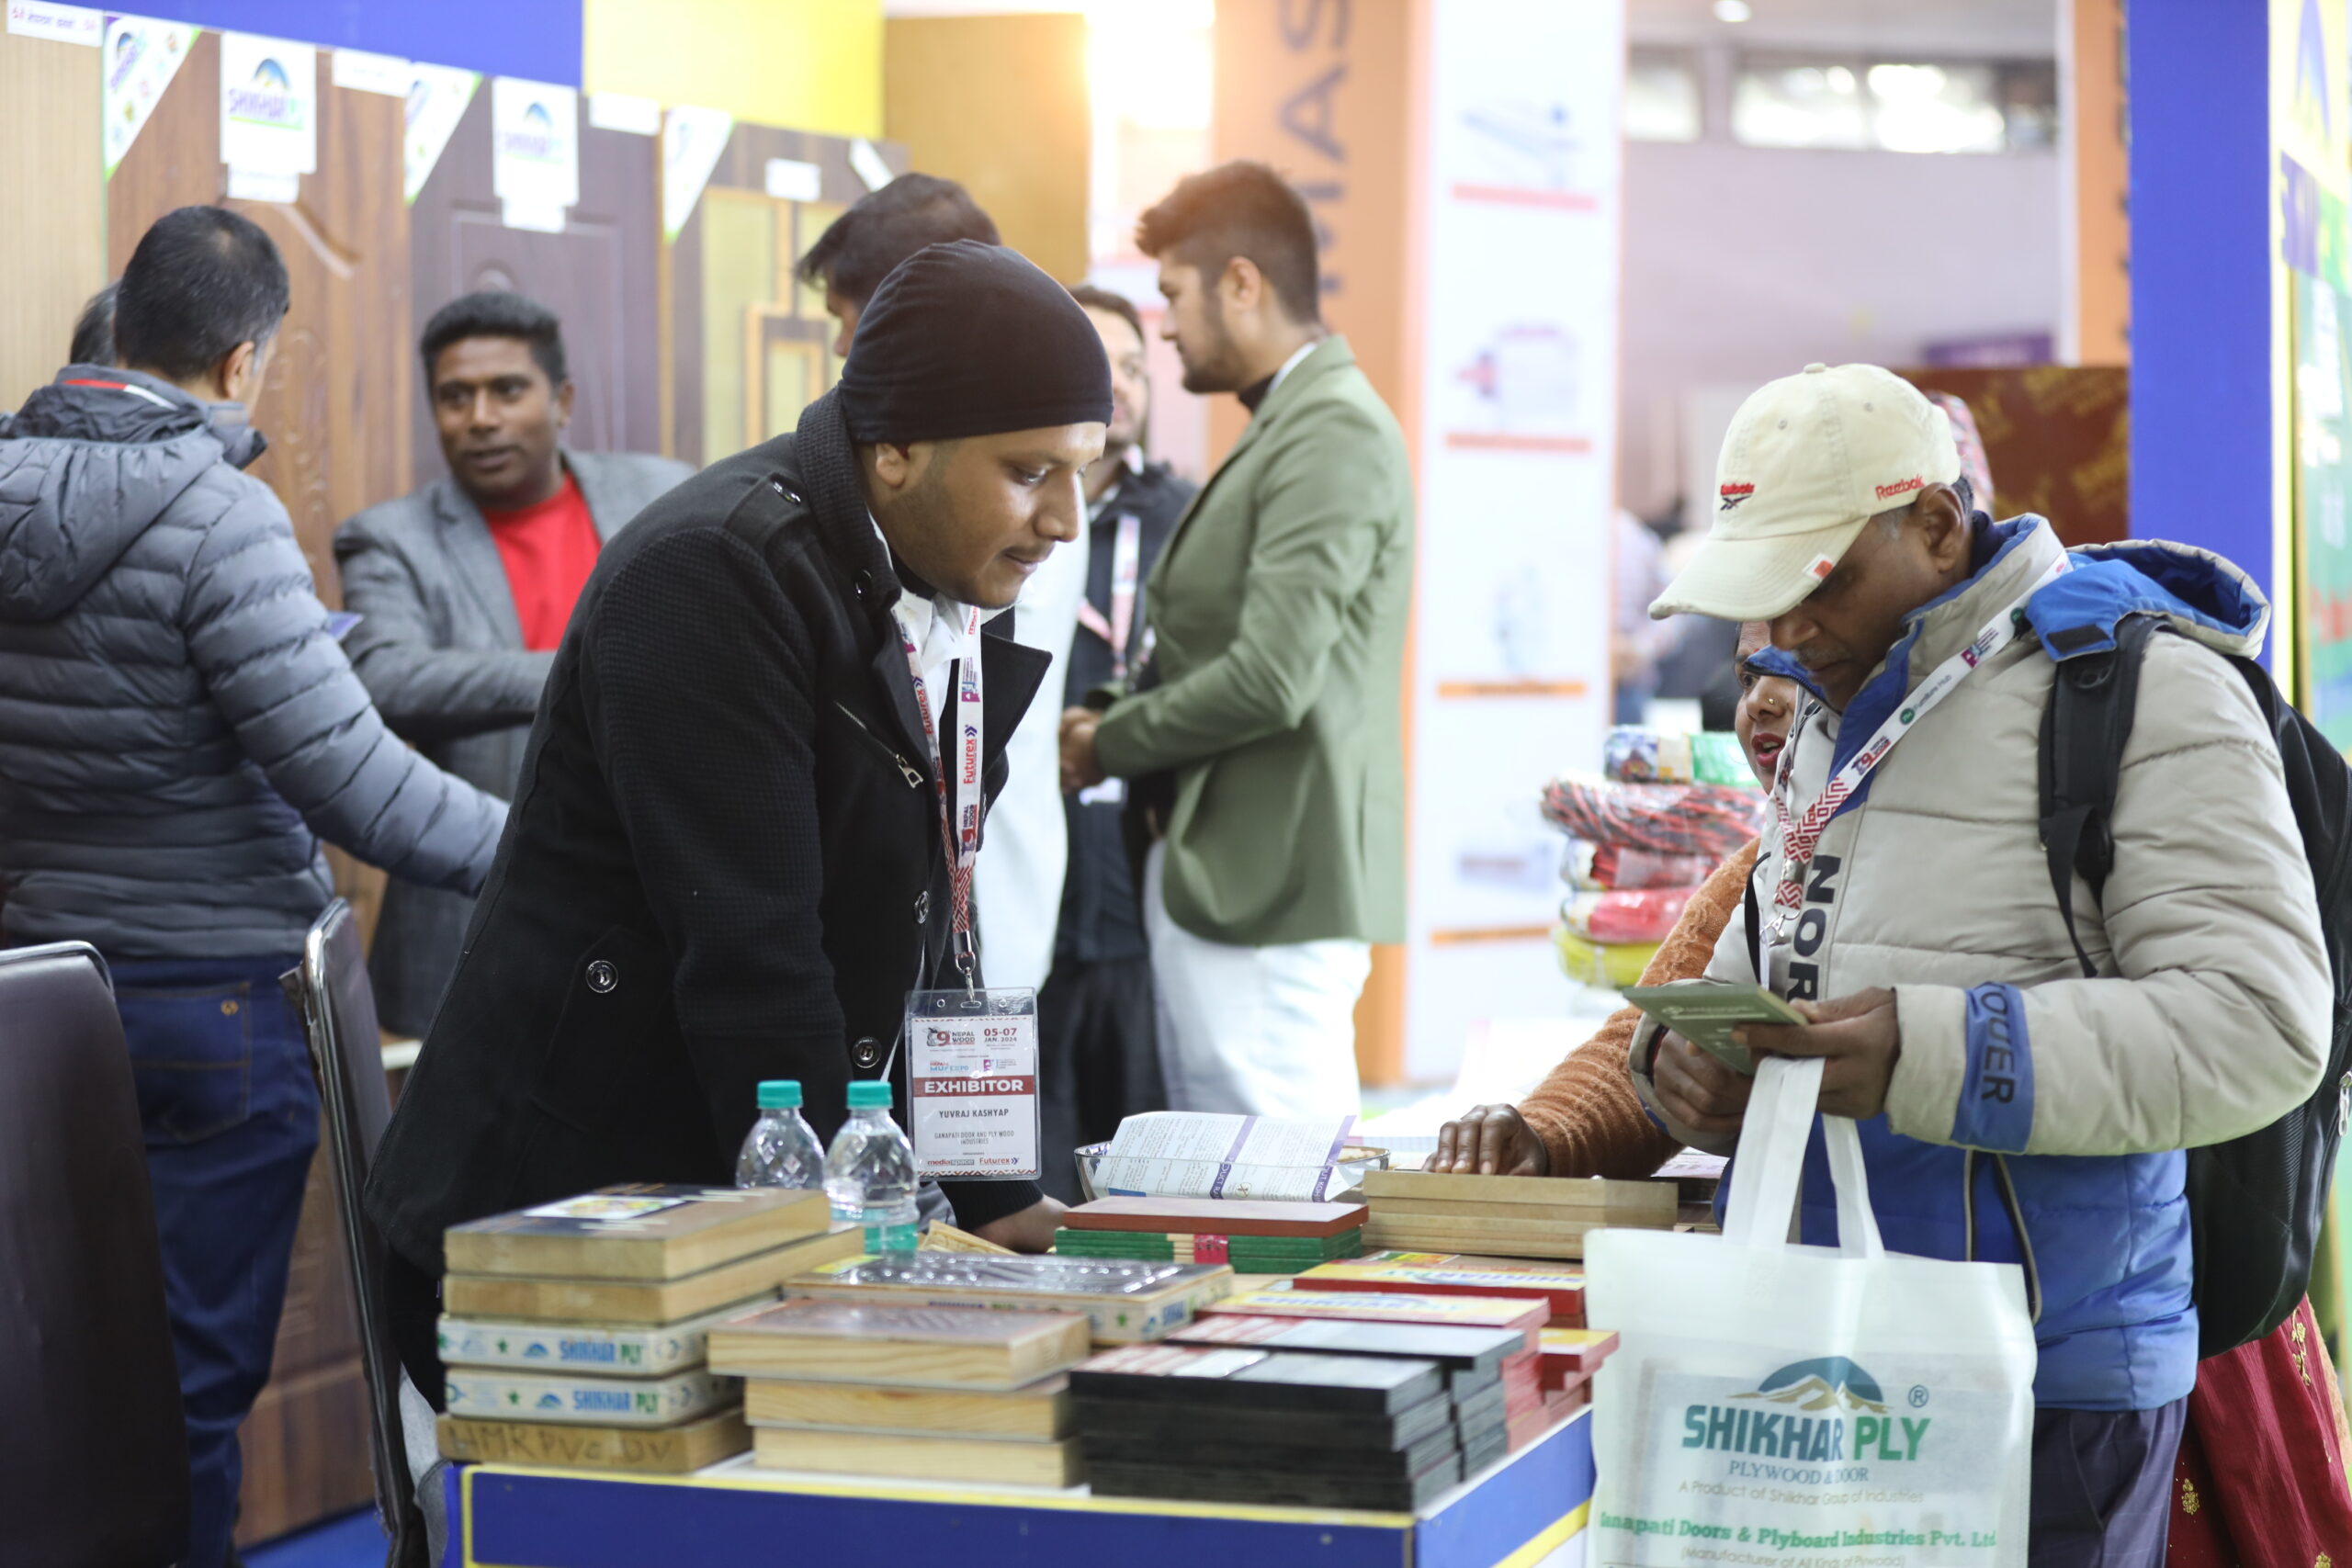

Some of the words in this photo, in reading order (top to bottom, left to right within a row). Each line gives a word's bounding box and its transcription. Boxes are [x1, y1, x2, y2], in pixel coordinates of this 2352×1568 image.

[1875, 473, 1923, 502] Reebok
[917, 689, 933, 735] Futurex
[963, 739, 974, 784] Futurex
[984, 1028, 1017, 1036] 05-07
[924, 1079, 1023, 1094] EXHIBITOR
[939, 1110, 970, 1119] YUVRAJ
[973, 1109, 1009, 1118] KASHYAP
[1681, 1404, 1844, 1461] SHIKHAR
[1853, 1416, 1931, 1461] PLY
[1729, 1460, 1822, 1484] PLYWOOD
[1679, 1481, 1689, 1492] A
[1691, 1481, 1746, 1497] Product
[1750, 1486, 1767, 1500] of
[1770, 1488, 1819, 1506] Shikhar
[1851, 1490, 1862, 1503] of
[1864, 1489, 1925, 1505] Industries
[1679, 1519, 1732, 1540] Doors
[1737, 1527, 1752, 1542] &
[1758, 1527, 1839, 1551] Plyboard
[1842, 1529, 1927, 1547] Industries
[1929, 1529, 1965, 1547] Pvt.
